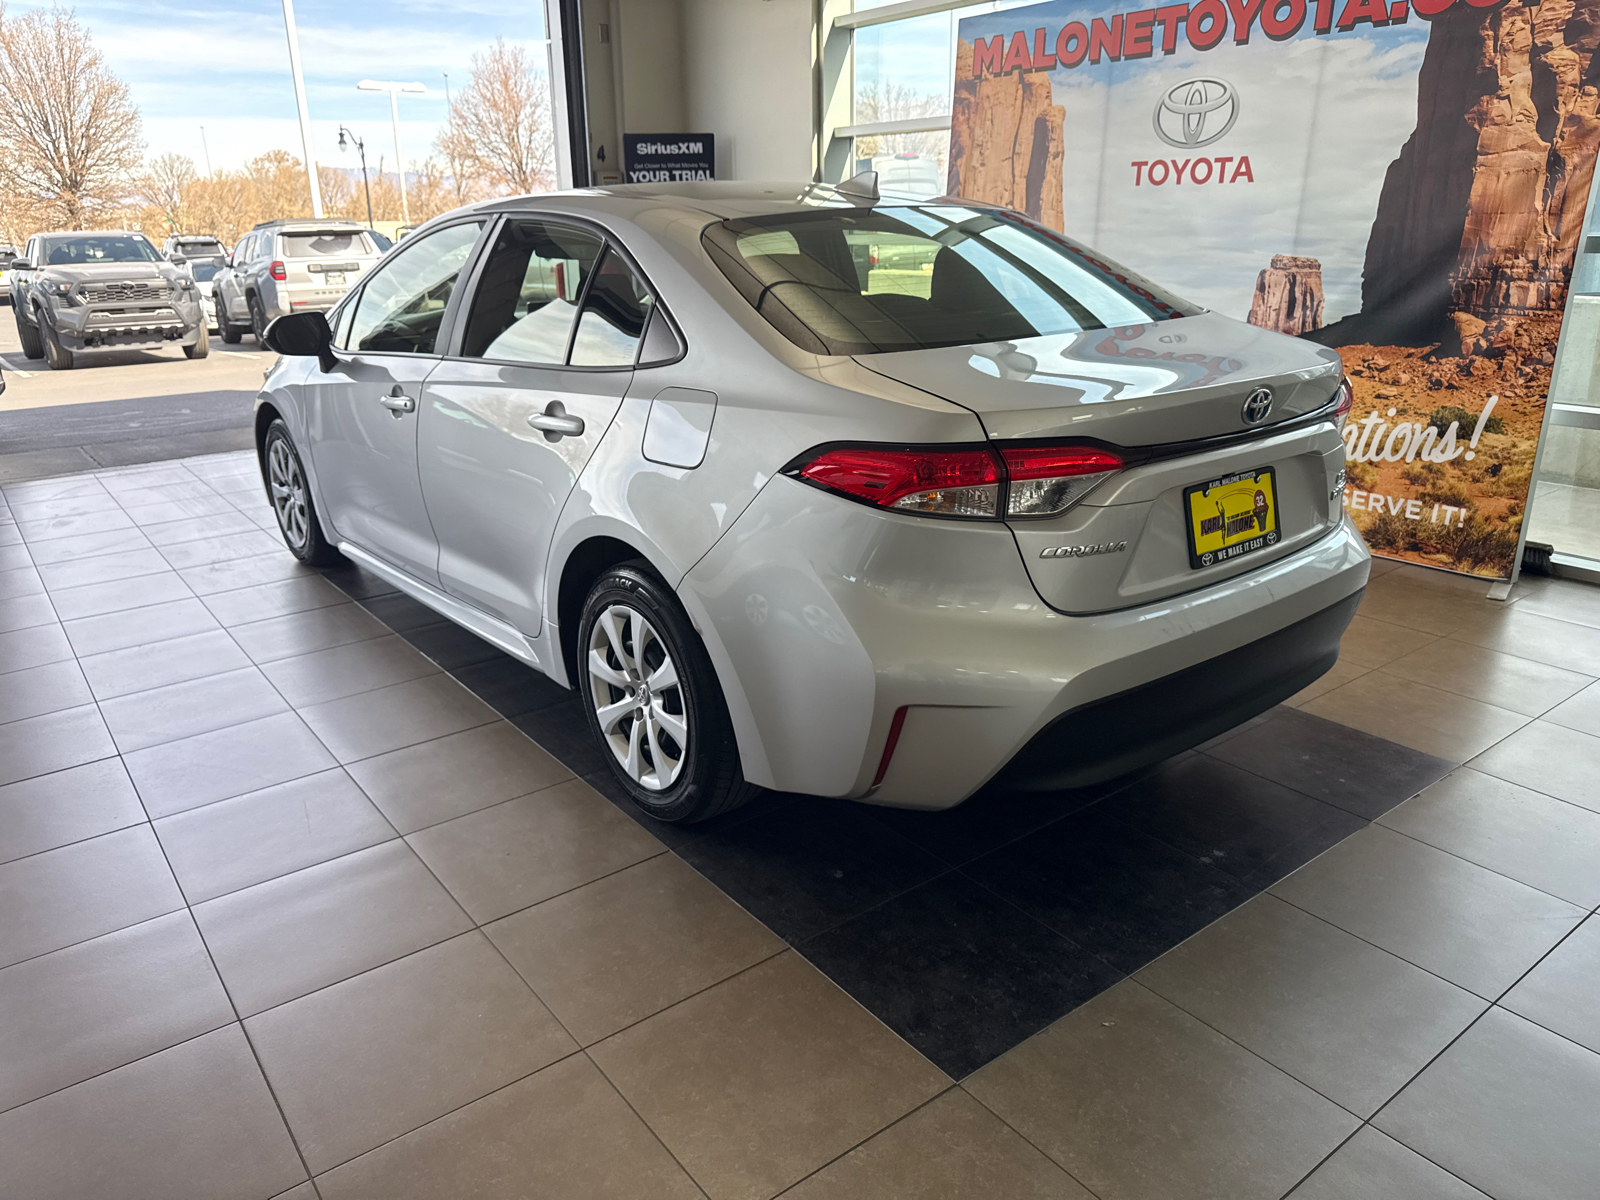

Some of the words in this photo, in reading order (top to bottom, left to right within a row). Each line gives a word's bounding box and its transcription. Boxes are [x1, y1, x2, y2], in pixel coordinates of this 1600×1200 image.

[972, 0, 1540, 80] MALONETOYOTA.
[597, 144, 606, 163] 4
[636, 142, 703, 155] SiriusXM
[629, 170, 670, 183] YOUR
[672, 169, 714, 182] TRIAL
[1131, 156, 1254, 186] TOYOTA
[1209, 480, 1221, 488] KARL
[1222, 475, 1240, 486] MALONE
[1240, 471, 1256, 480] TOYOTA
[1256, 495, 1264, 506] 32
[1201, 515, 1221, 537] KARL
[1227, 514, 1255, 538] MALONE
[1431, 503, 1466, 528] IT!
[1217, 550, 1227, 561] WE
[1228, 544, 1243, 557] MAKE
[1244, 541, 1249, 550] IT
[1250, 538, 1263, 550] EASY
